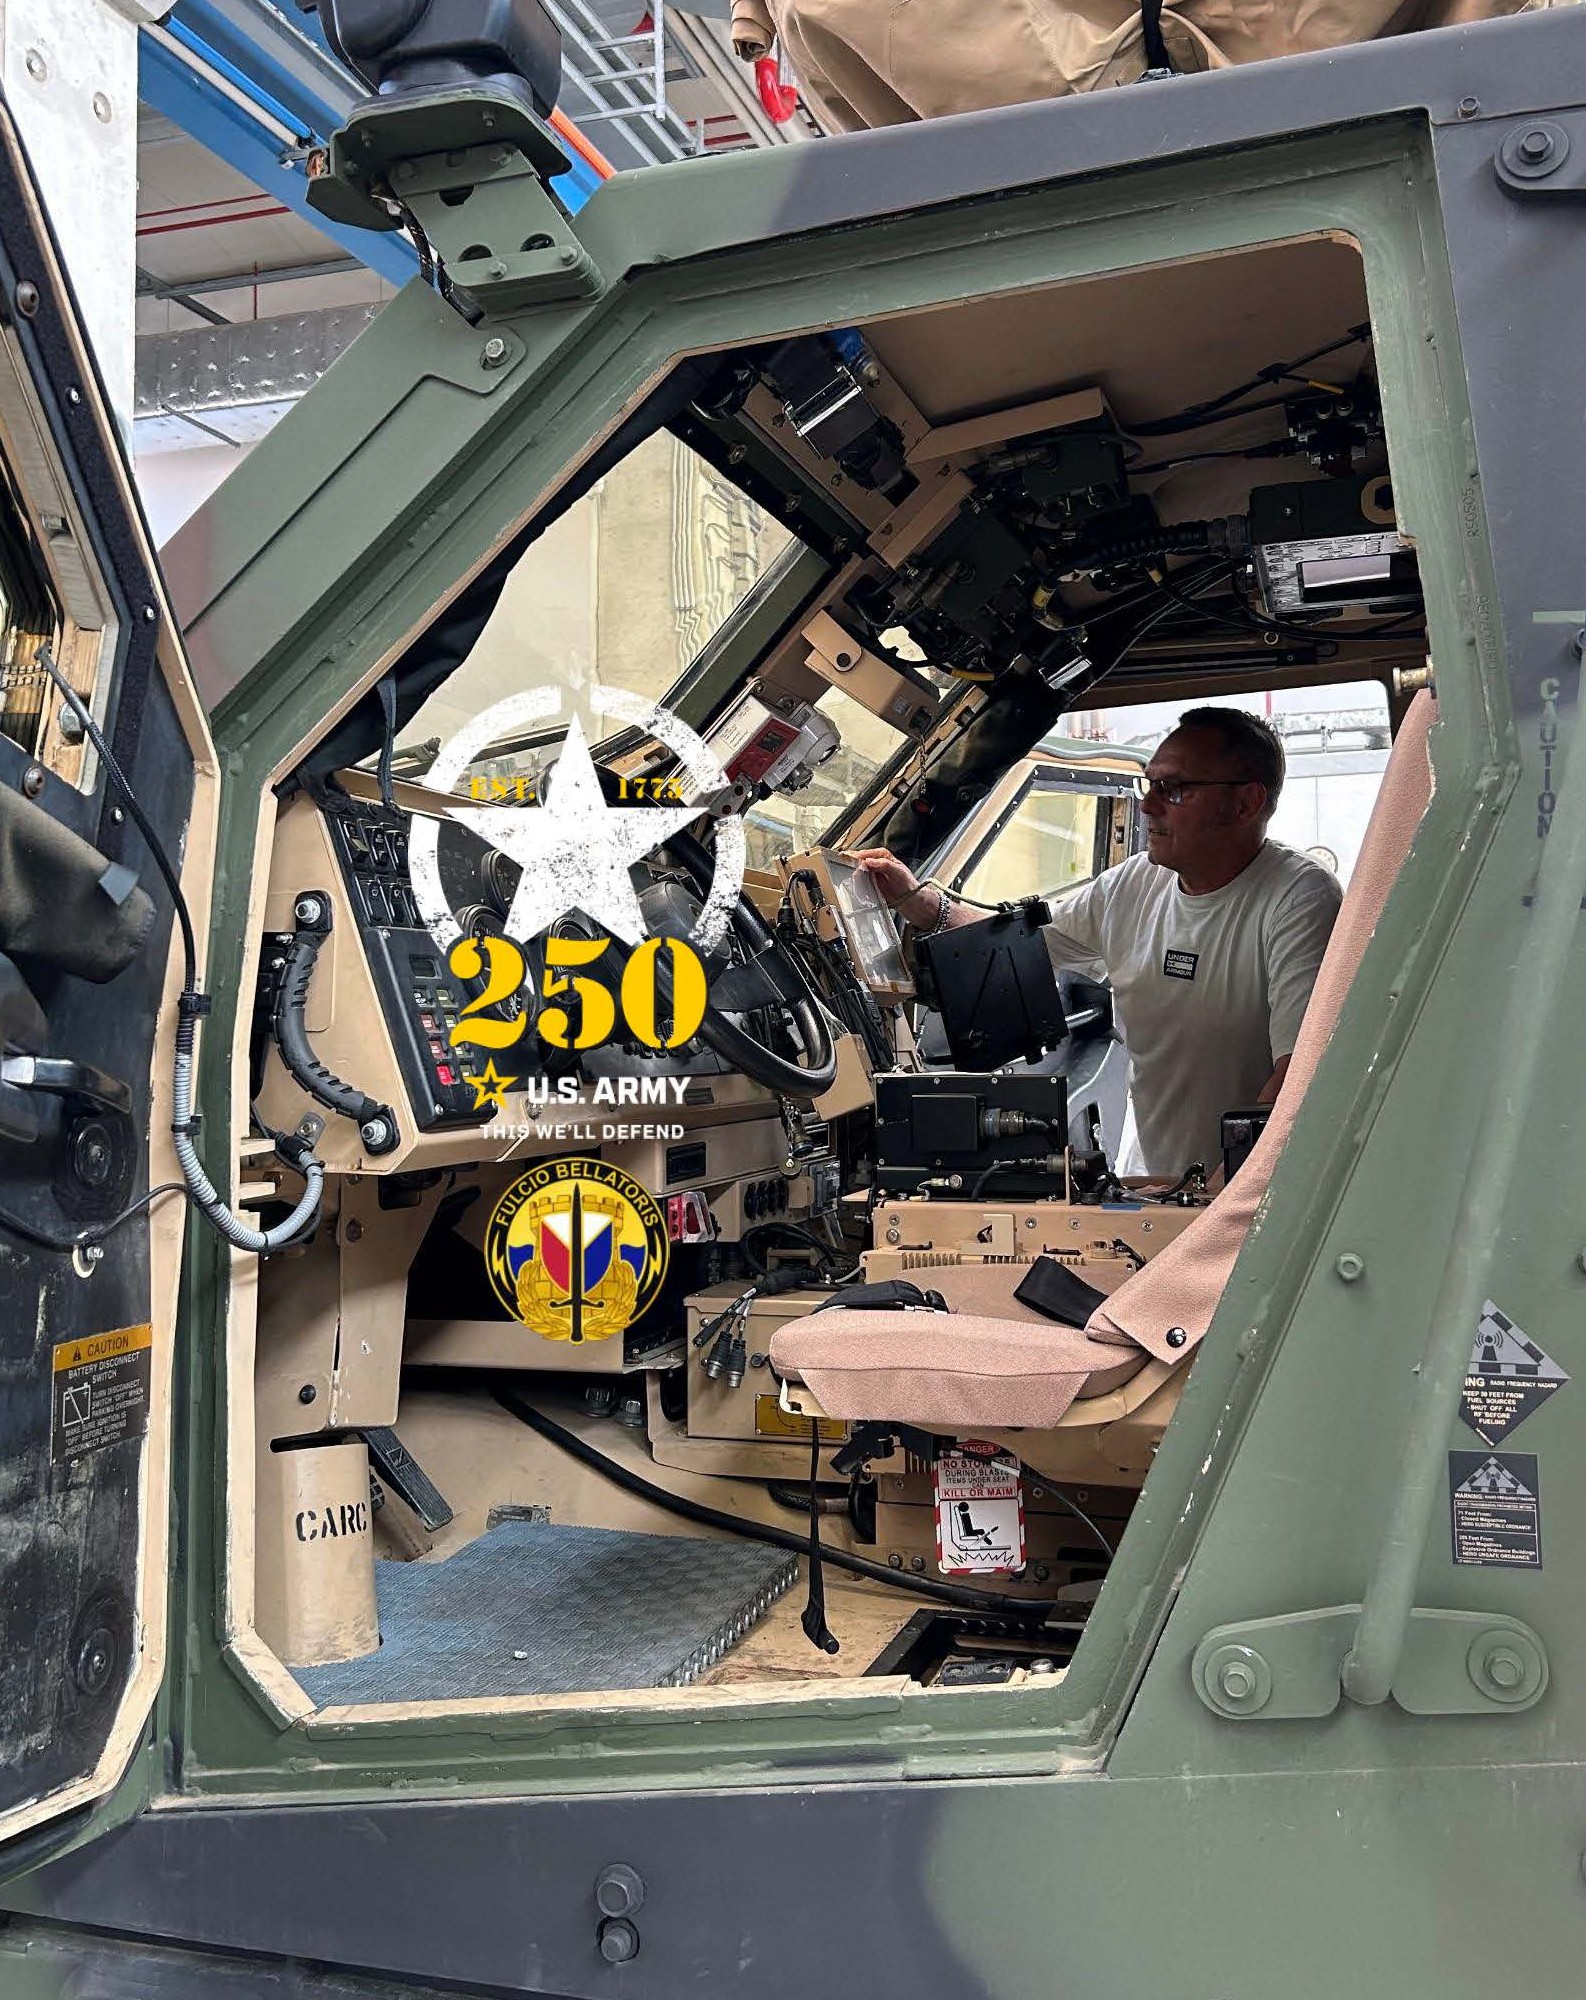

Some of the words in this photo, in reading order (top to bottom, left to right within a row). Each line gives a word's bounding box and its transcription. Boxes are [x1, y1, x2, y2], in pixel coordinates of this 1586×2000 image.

[1167, 953, 1195, 963] UNDER
[1166, 967, 1192, 977] ARMOUR
[87, 1335, 129, 1357] CAUTION
[68, 1362, 98, 1379] BATTERY
[99, 1352, 140, 1370] DISCONNECT
[92, 1370, 117, 1384] SWITCH
[1478, 1418, 1506, 1426] FUELING
[961, 1443, 995, 1453] ANGER
[943, 1460, 957, 1469] NO
[945, 1469, 977, 1478] DURING
[968, 1476, 991, 1484] UNDER
[944, 1488, 967, 1497] KILL
[969, 1488, 984, 1497] OR
[987, 1487, 1014, 1496] MAIM
[296, 1502, 367, 1542] CARC
